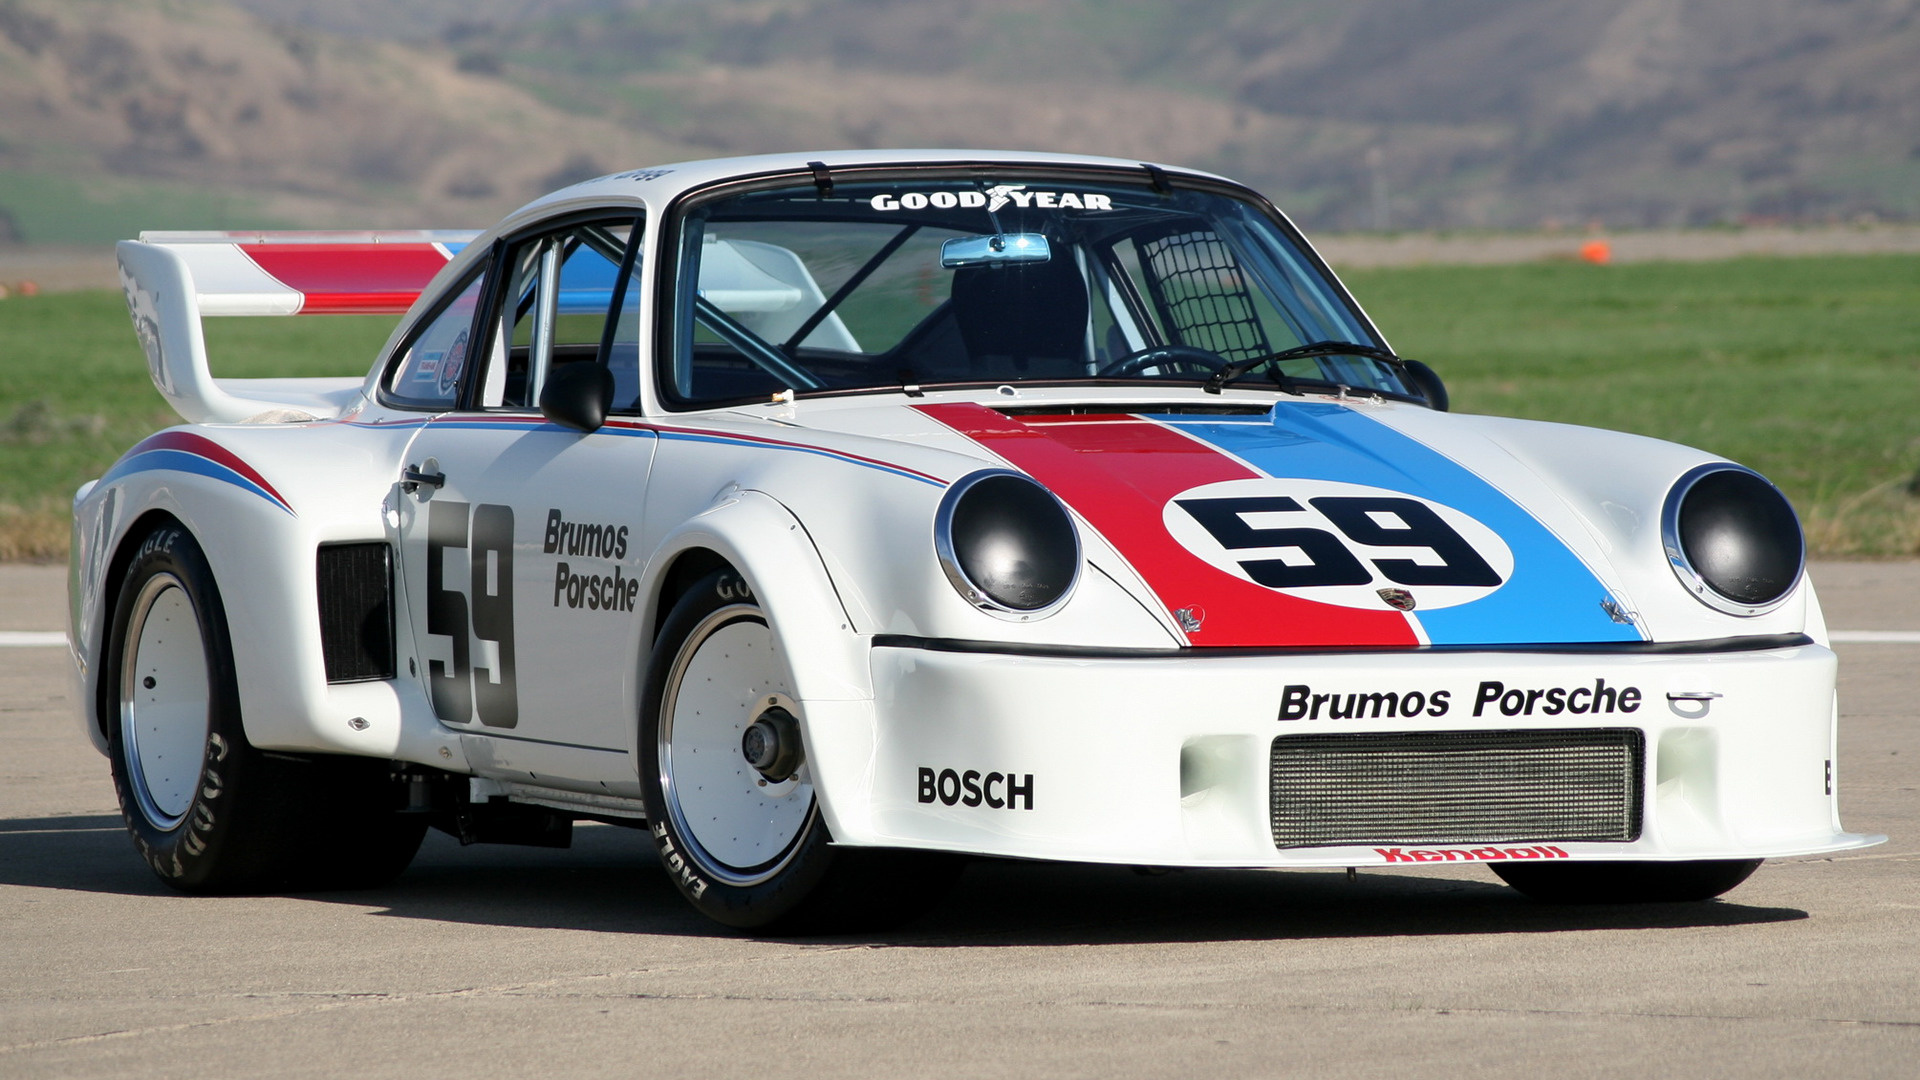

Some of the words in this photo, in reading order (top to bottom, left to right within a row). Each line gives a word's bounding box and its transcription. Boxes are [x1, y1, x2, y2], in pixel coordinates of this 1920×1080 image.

[543, 508, 629, 560] Brumos
[1173, 495, 1503, 588] 59
[553, 562, 639, 613] Porsche
[427, 500, 519, 730] 59
[1277, 684, 1451, 721] Brumos
[1472, 678, 1642, 717] Porsche
[918, 766, 1034, 810] BOSCH
[652, 821, 708, 900] EAGLE
[1373, 845, 1570, 863] Kendall
